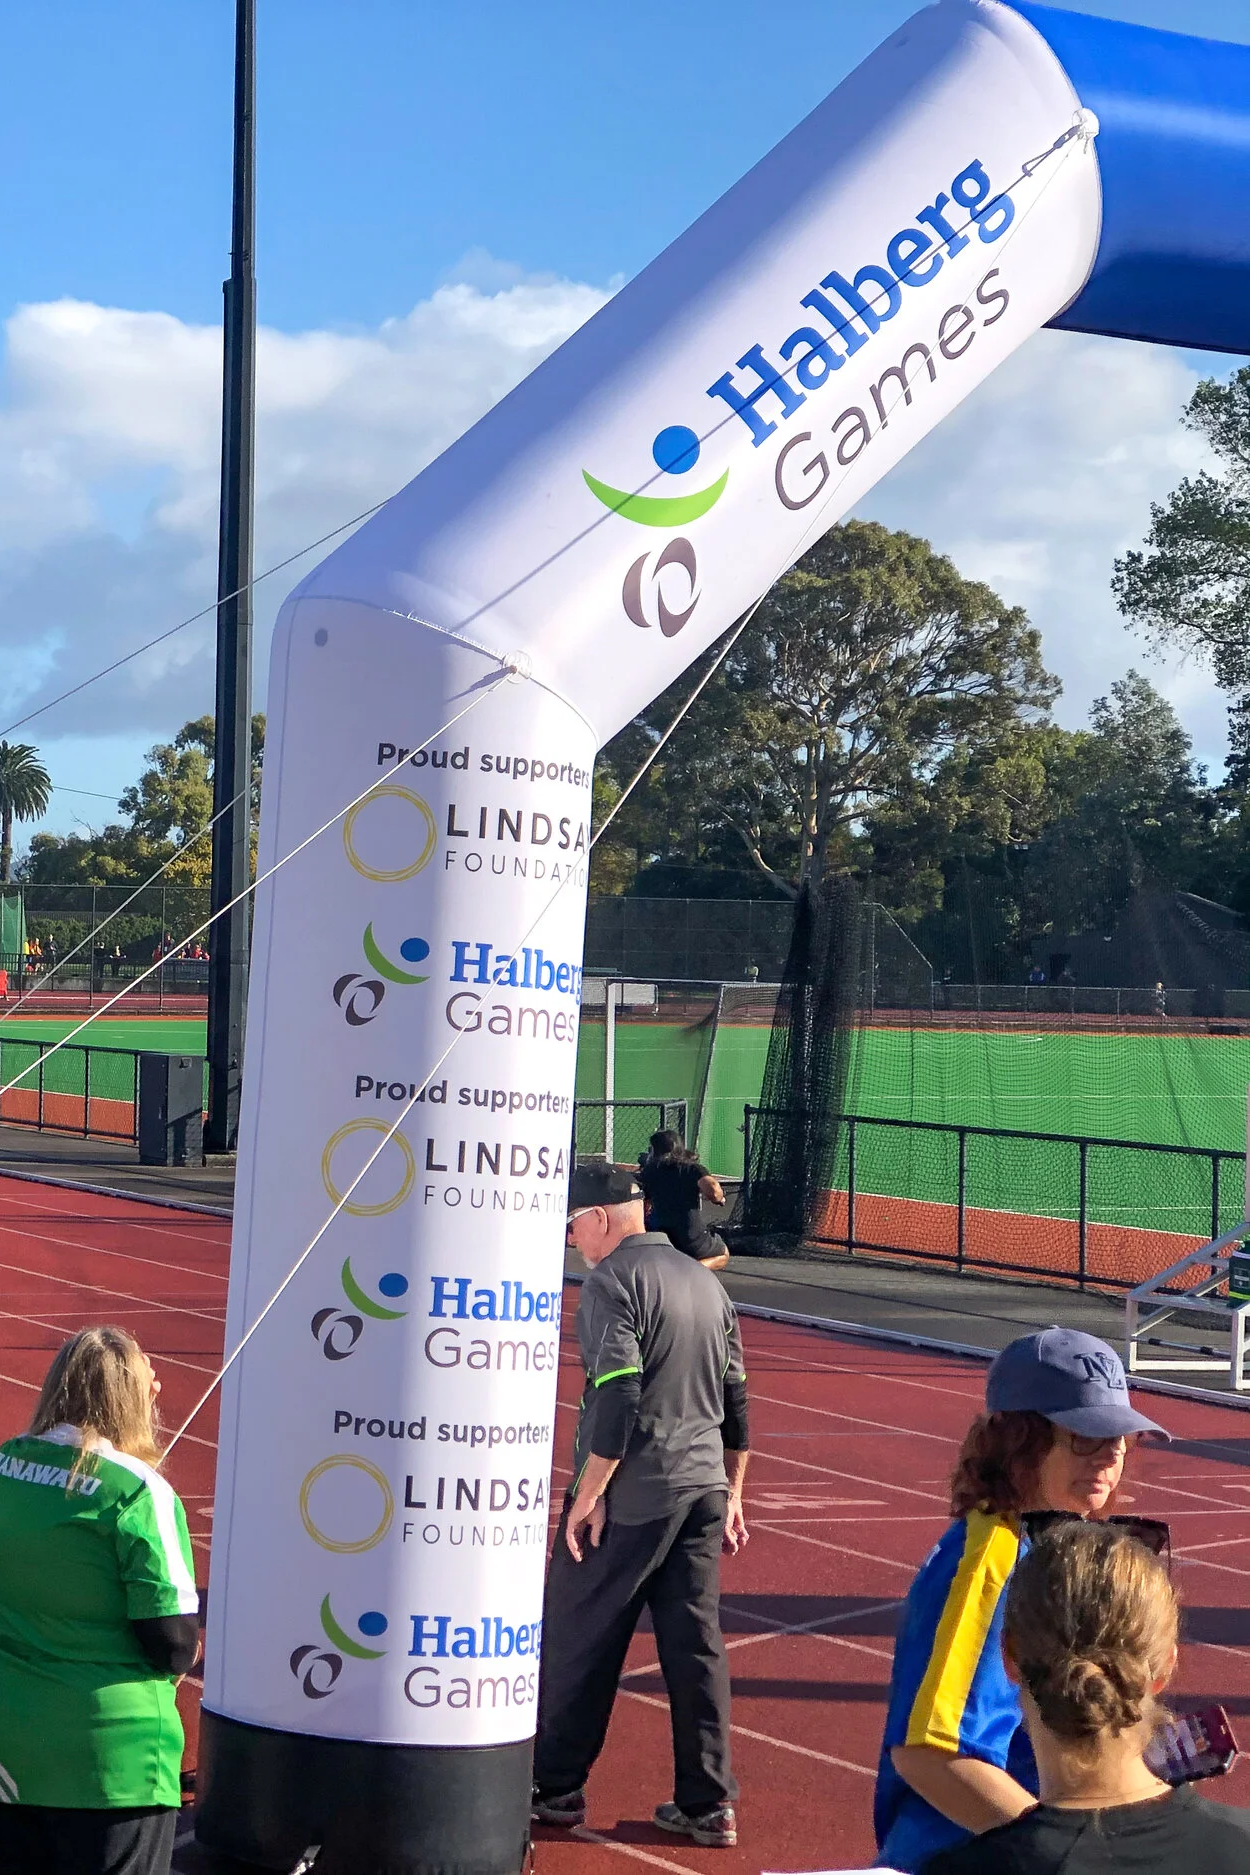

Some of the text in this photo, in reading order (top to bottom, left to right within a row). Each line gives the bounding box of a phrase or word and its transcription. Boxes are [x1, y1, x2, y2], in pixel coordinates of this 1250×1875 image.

[706, 159, 1015, 448] Halberg
[774, 268, 1010, 511] Games
[377, 743, 590, 789] Proud supporters
[445, 992, 575, 1043] Games
[355, 1075, 569, 1115] Proud supporters
[424, 1185, 567, 1213] FOUNDATIO
[424, 1327, 555, 1371] Games
[1073, 1351, 1125, 1390] NZ
[333, 1410, 549, 1448] Proud supporters
[403, 1522, 547, 1546] FOUNDATIO
[404, 1666, 535, 1708] Games
